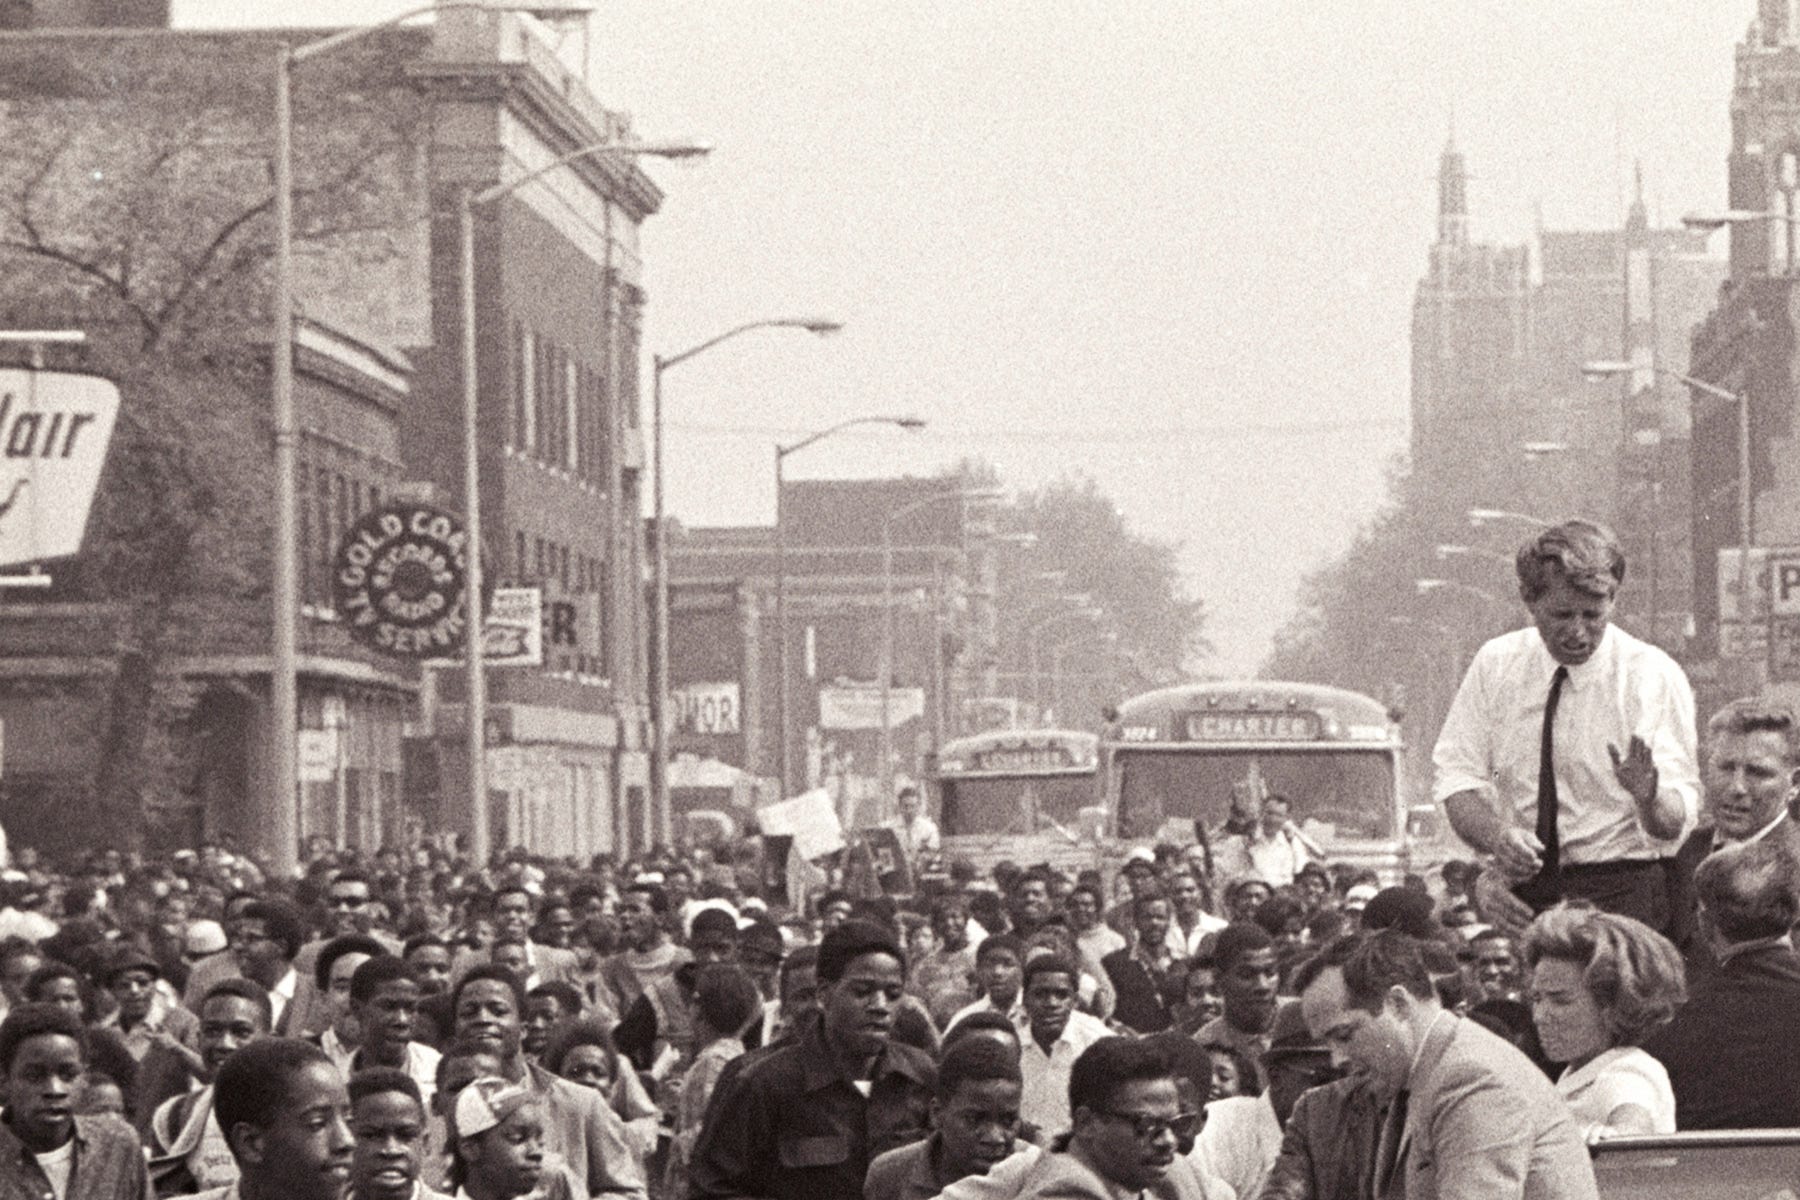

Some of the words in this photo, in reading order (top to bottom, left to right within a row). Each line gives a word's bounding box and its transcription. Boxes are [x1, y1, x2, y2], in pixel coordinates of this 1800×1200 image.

[340, 513, 403, 588] GOLD
[372, 543, 453, 589] RECORDS
[1203, 716, 1306, 737] CHARTER
